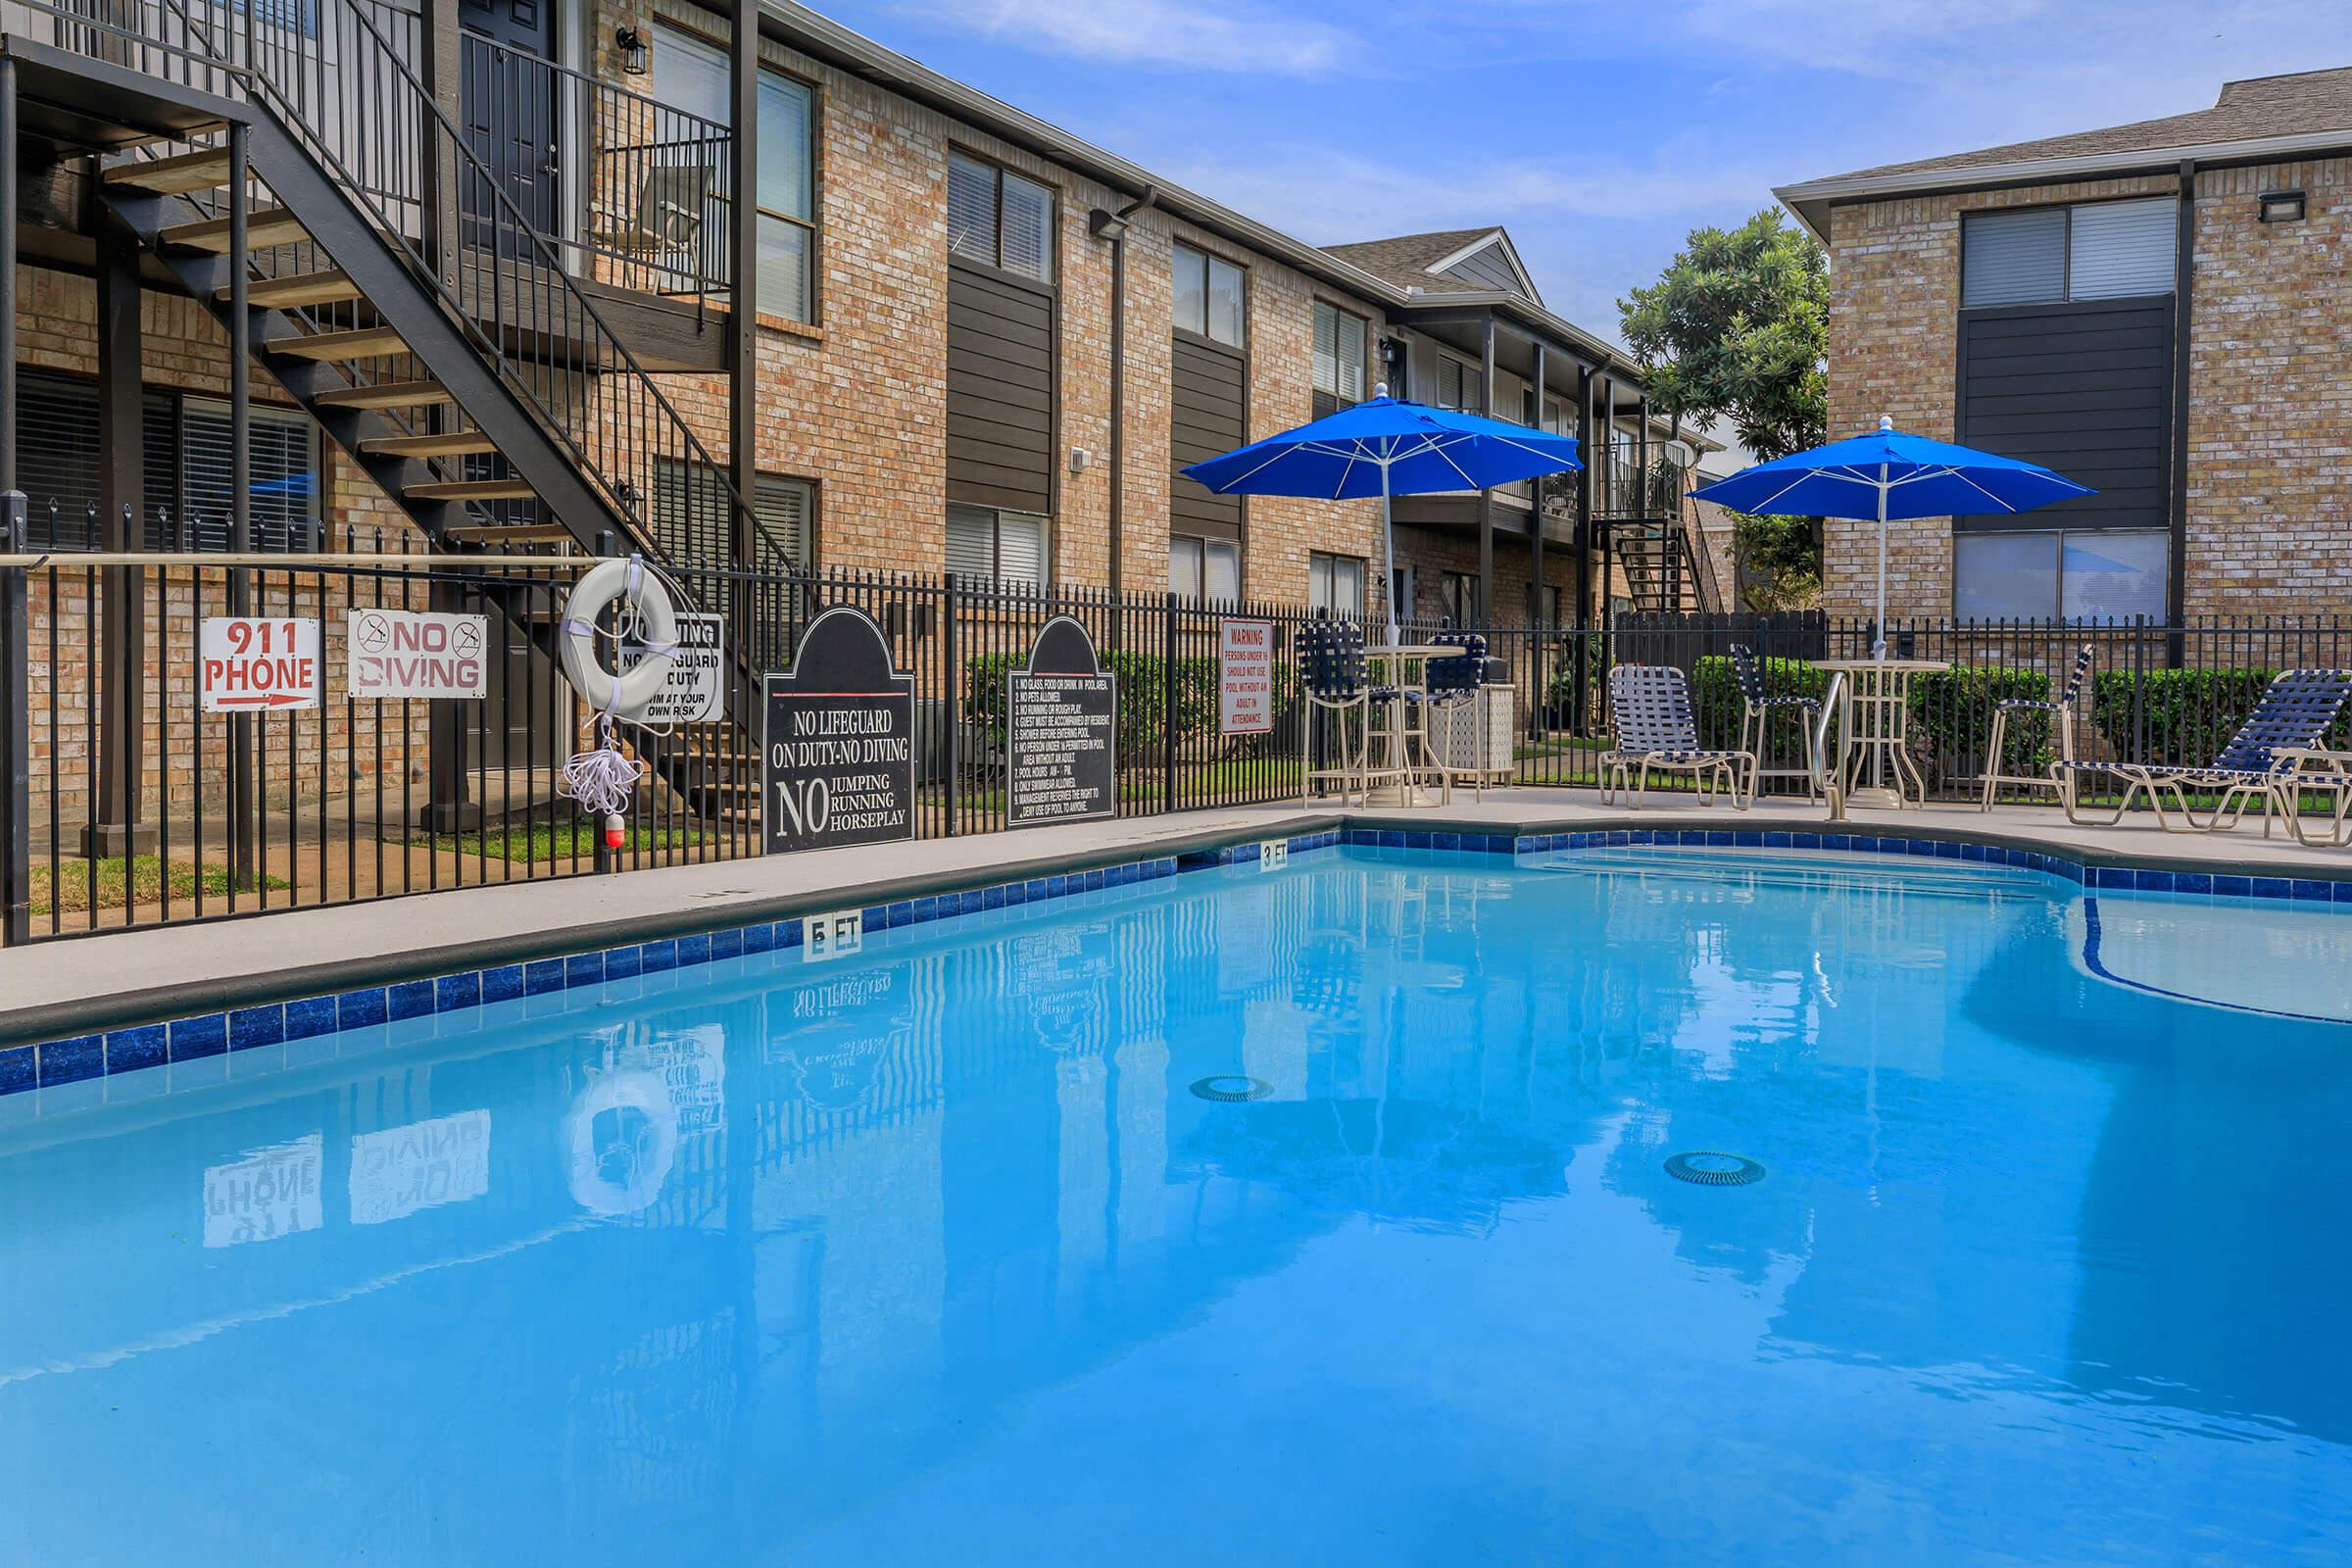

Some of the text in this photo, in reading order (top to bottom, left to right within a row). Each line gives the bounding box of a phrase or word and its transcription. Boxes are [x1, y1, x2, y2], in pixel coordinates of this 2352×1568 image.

[227, 621, 296, 655] 911
[394, 621, 447, 653] NO
[1231, 628, 1263, 646] WARNING
[1225, 650, 1246, 661] PERSONS
[1247, 650, 1262, 661] UNDER
[205, 659, 313, 691] PHONE
[1227, 666, 1246, 676] SHOULD
[1247, 666, 1255, 676] NOT
[667, 672, 700, 685] DUTY
[1020, 679, 1027, 690] NO
[1044, 679, 1057, 690] FOOD
[1057, 679, 1063, 690] OR
[1064, 679, 1077, 690] DRINK
[1078, 679, 1083, 690] IN
[1084, 679, 1097, 690] POOL
[1226, 682, 1267, 693] POOL WITHOUT AN
[666, 694, 678, 704] AT
[680, 694, 705, 704] YOUR
[1020, 691, 1027, 703] NO
[1028, 691, 1039, 703] PETS
[1237, 698, 1256, 708] ADULT IN
[648, 707, 669, 716] OWN
[1020, 704, 1027, 715] NO
[1028, 704, 1048, 715] RUNNING
[1049, 704, 1054, 714] OR
[1054, 704, 1070, 714] ROUGH
[794, 710, 893, 736] NO LIFEGUARD
[1020, 716, 1035, 727] GUEST
[1036, 716, 1047, 726] MUST
[1048, 715, 1054, 726] BE
[1054, 715, 1084, 726] ACCOMPANIED
[1084, 715, 1090, 725] BY
[1232, 713, 1261, 724] ATTENDANCE
[1020, 729, 1039, 740] SHOWER
[1040, 728, 1057, 739] BEFORE
[1057, 728, 1077, 738] ENTERING
[1020, 742, 1027, 753] NO
[1027, 741, 1045, 753] PERSON
[1046, 740, 1059, 752] UNDER
[1066, 740, 1088, 751] PERMITTED
[1089, 739, 1094, 750] IN
[772, 743, 796, 768] ON
[863, 737, 908, 762] DIVING
[1023, 754, 1035, 765] AREA
[1035, 754, 1054, 764] WITHOUT
[1054, 753, 1061, 763] AN
[1020, 767, 1031, 778] POOL
[1032, 766, 1048, 777] HOURS
[831, 773, 890, 794] JUMPING
[1019, 781, 1031, 792] ONLY
[831, 792, 895, 812] RUNNING
[1019, 792, 1049, 805] MANAGEMENT
[1050, 790, 1071, 802] RESERVES
[1080, 788, 1092, 799] RIGHT
[1093, 787, 1099, 798] TO
[775, 777, 830, 837] NO
[1023, 806, 1034, 816] DENY
[1035, 804, 1045, 815] USE
[1045, 804, 1051, 814] OF
[1051, 803, 1062, 814] POOL
[1063, 802, 1069, 813] TO
[830, 809, 906, 831] HORSEPLAY
[835, 915, 859, 938] FT
